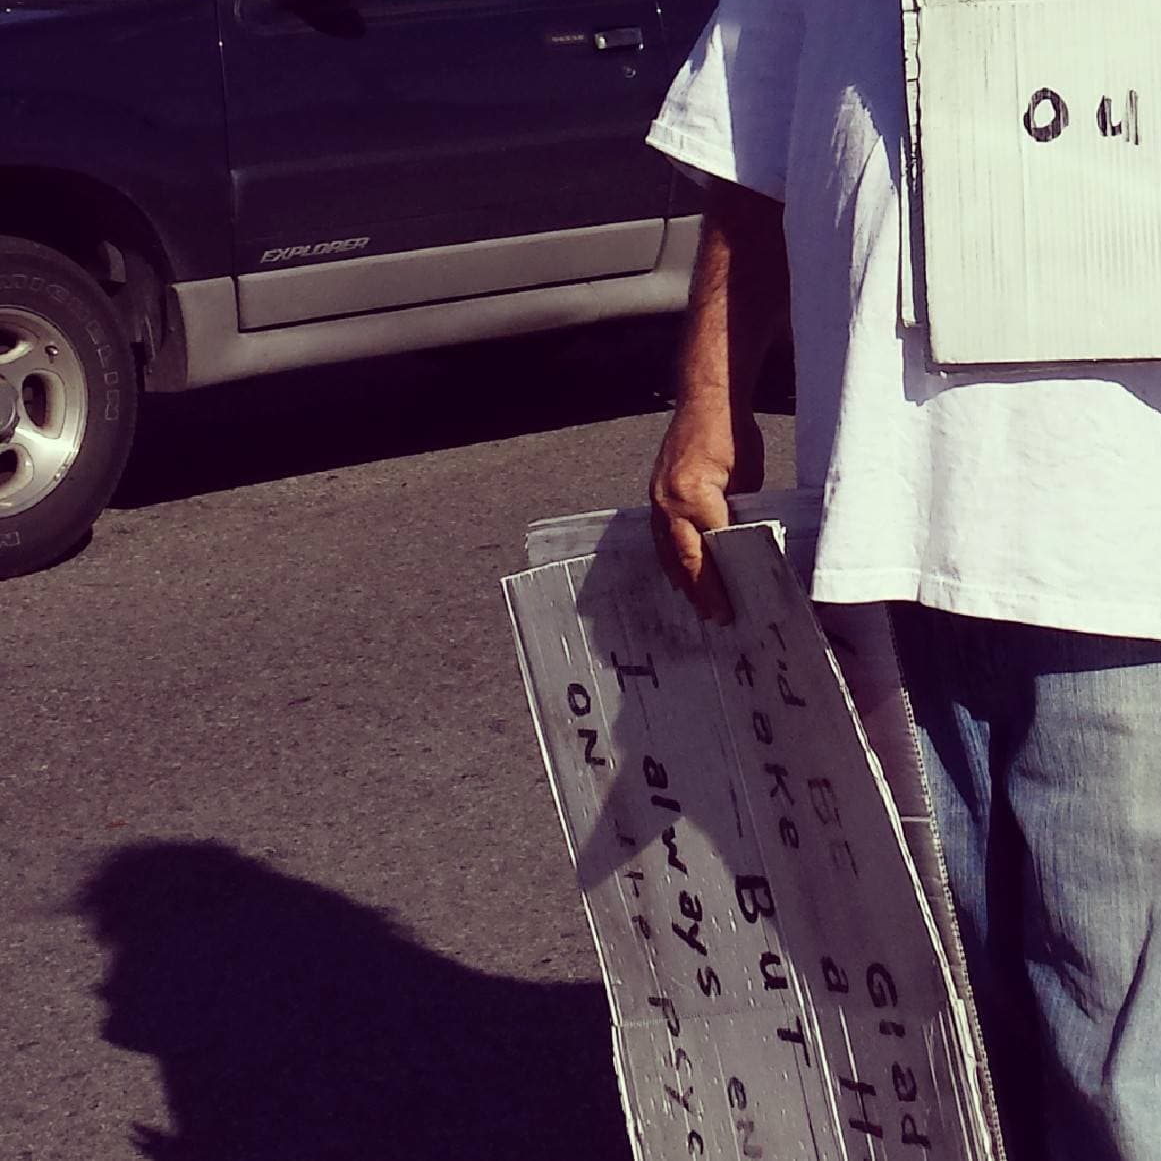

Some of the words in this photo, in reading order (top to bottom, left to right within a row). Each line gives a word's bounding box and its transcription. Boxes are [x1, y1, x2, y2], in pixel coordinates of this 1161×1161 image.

[260, 237, 370, 263] EXPLORER
[734, 653, 800, 850] take
[642, 755, 722, 998] always
